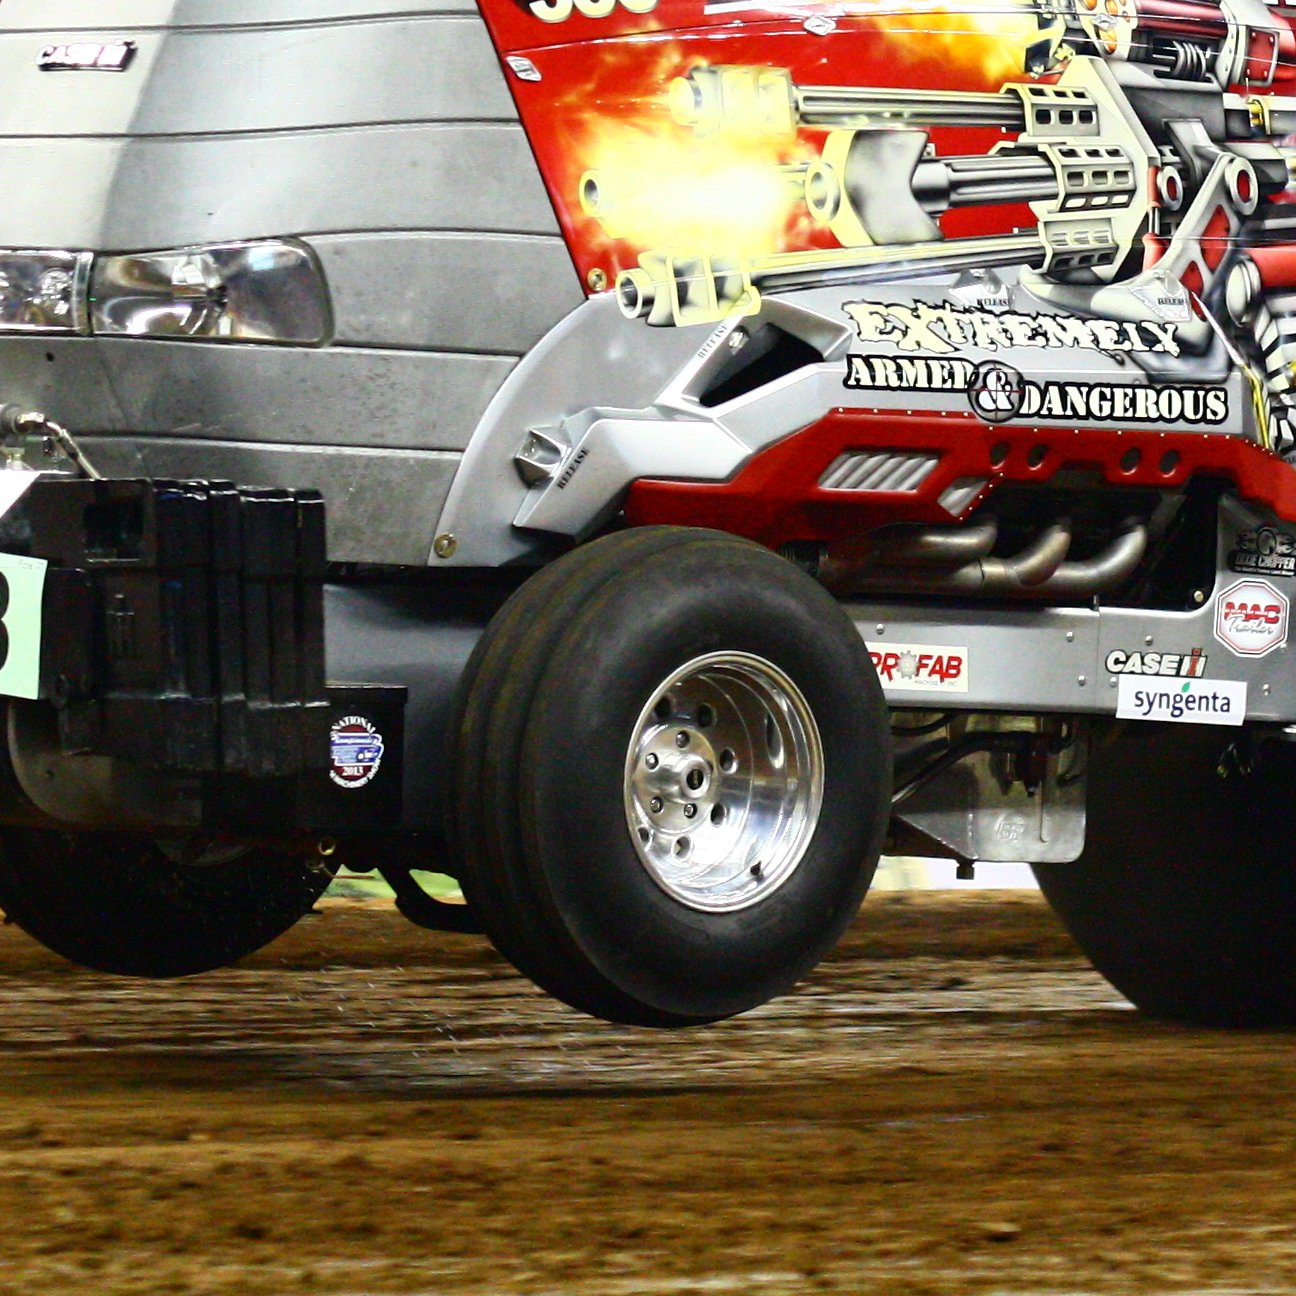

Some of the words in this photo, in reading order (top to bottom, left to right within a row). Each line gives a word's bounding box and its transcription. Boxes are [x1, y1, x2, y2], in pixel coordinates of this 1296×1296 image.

[842, 300, 1181, 359] EXTREMELY
[974, 367, 1014, 411] &
[1017, 384, 1228, 421] DANGEROUS
[1224, 602, 1281, 625] MAC
[1134, 691, 1231, 718] syngenta
